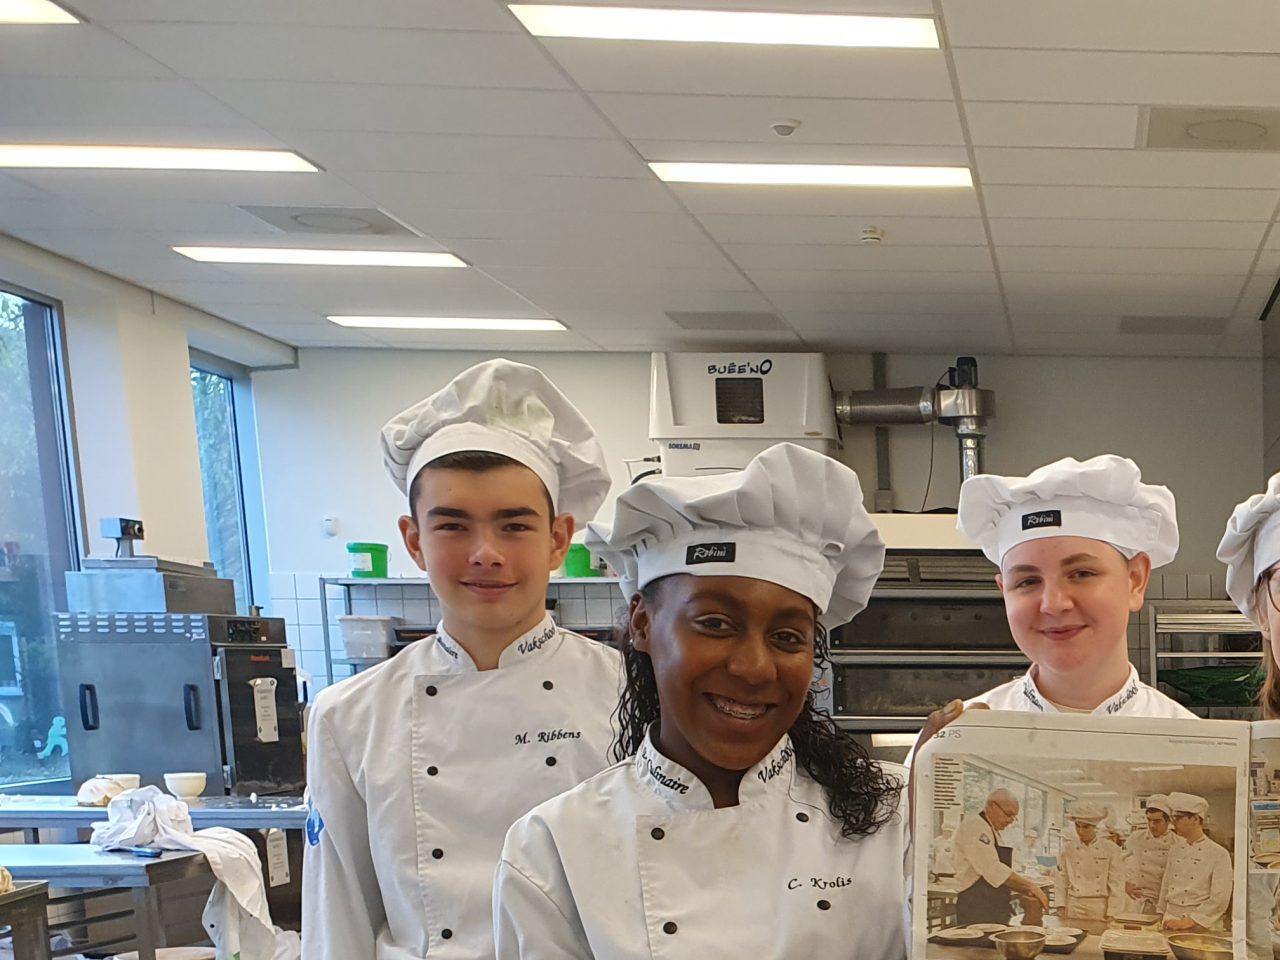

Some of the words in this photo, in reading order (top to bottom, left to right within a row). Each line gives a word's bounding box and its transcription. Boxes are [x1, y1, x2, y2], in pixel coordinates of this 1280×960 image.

[514, 732, 531, 745] M.
[537, 729, 582, 744] Ribbens
[948, 729, 962, 738] PS
[787, 878, 803, 890] C.
[810, 876, 852, 890] Krolis
